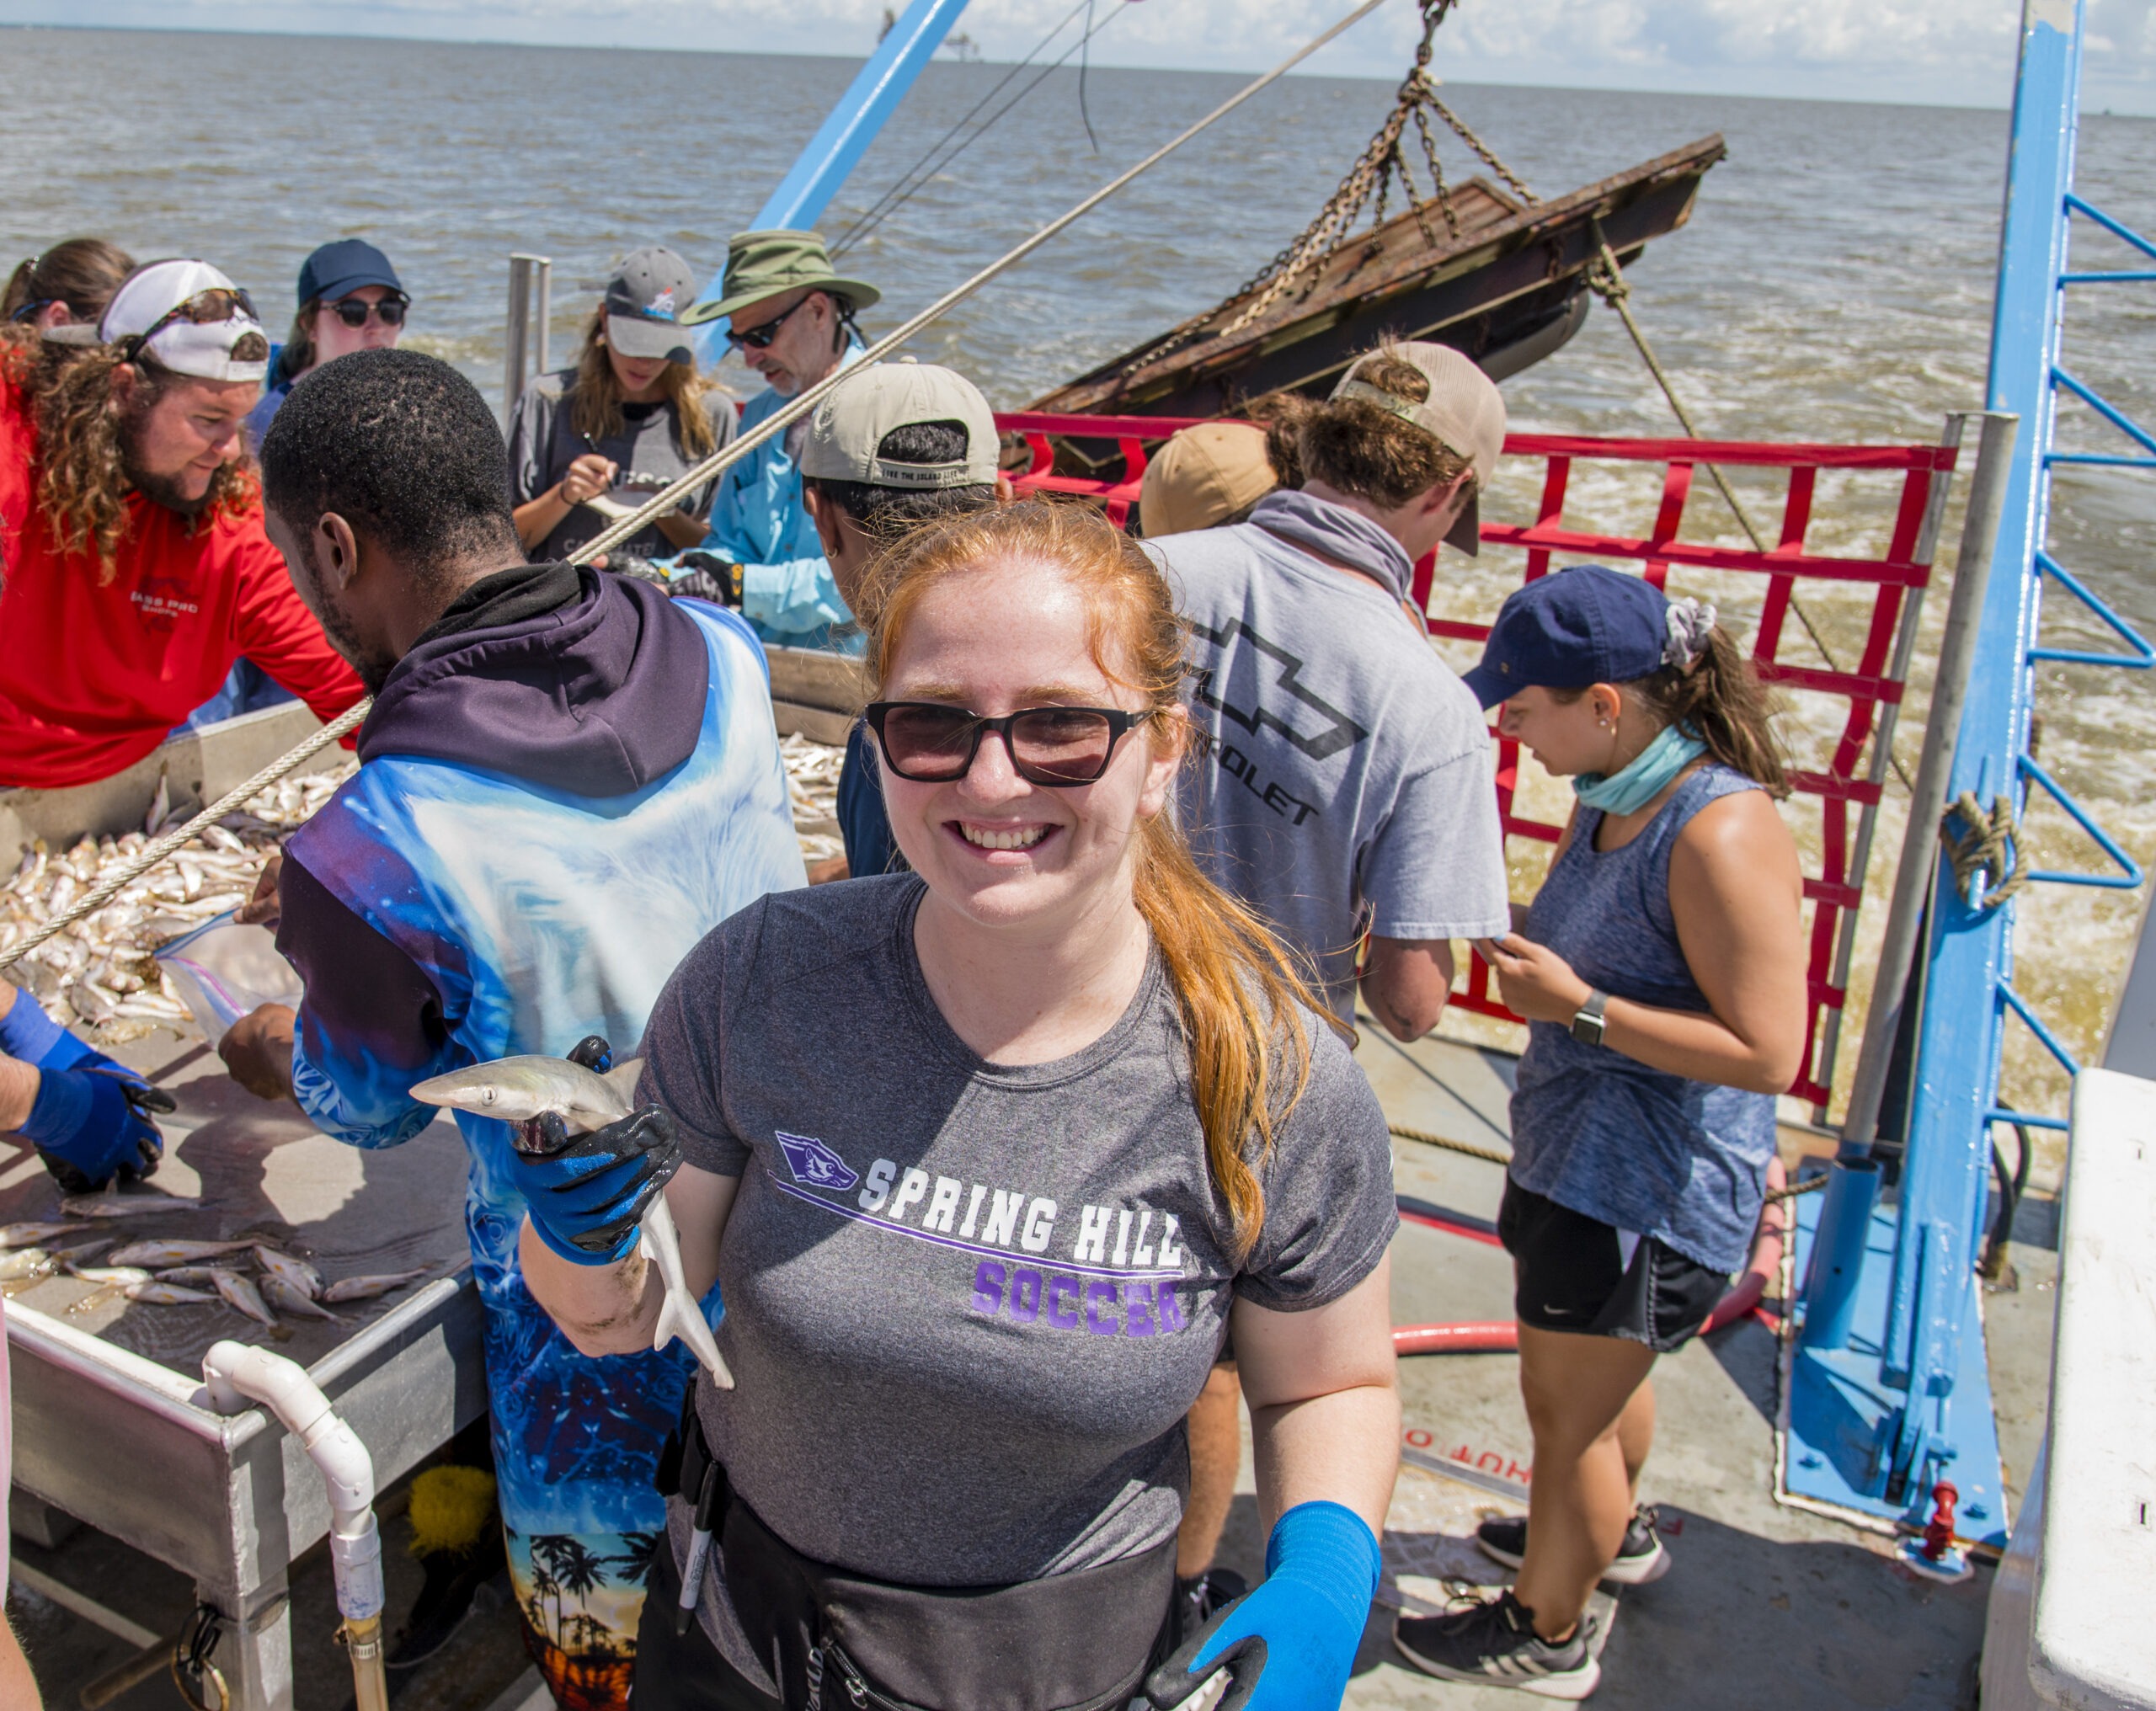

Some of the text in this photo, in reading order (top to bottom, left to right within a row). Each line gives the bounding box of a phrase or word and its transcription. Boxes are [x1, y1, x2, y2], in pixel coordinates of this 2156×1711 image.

[901, 472, 914, 481] THE
[167, 599, 199, 614] PRO
[857, 1156, 1181, 1266] SPRING HILL
[971, 1261, 1187, 1338] SOCCER
[1449, 1443, 1533, 1485] HUT
